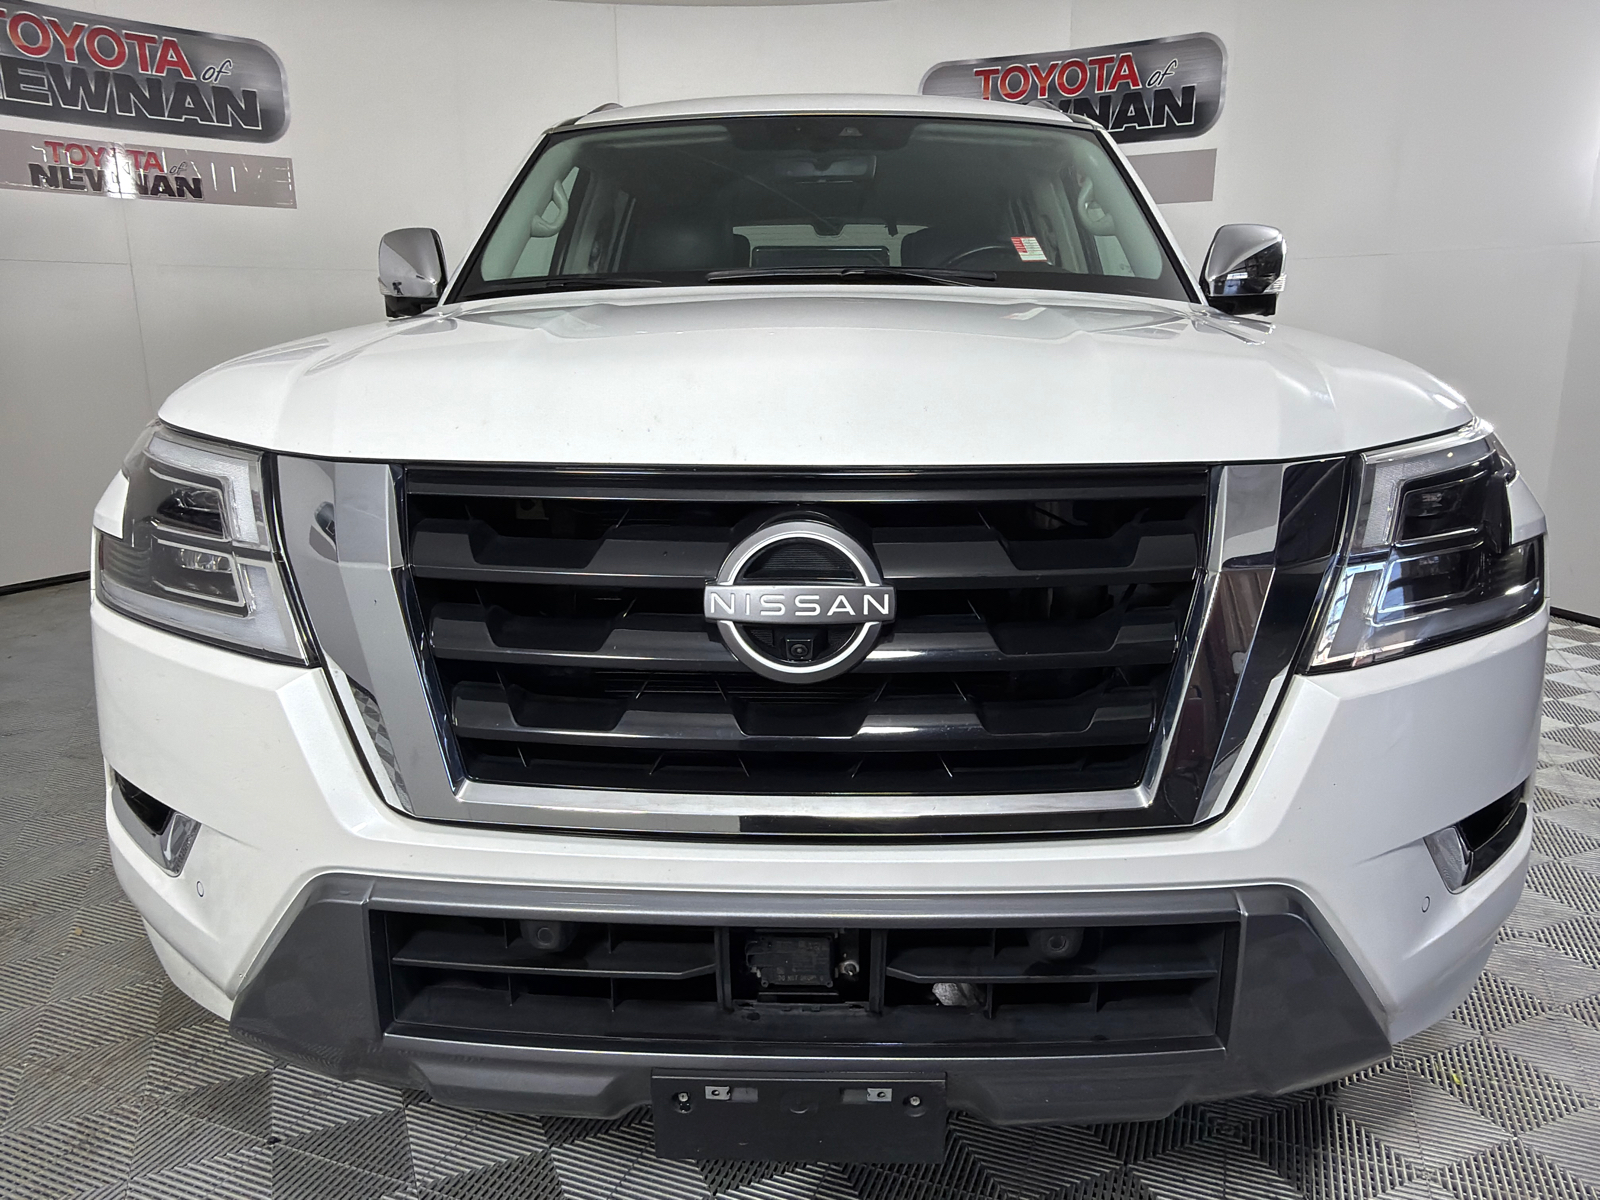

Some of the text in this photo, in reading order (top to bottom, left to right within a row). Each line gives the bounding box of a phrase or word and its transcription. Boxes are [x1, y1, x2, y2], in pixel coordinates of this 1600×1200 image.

[0, 8, 233, 83] OYOTA of
[0, 53, 262, 130] EWNAN
[974, 52, 1178, 100] TOYOTA of
[1057, 83, 1198, 132] NAN
[44, 140, 188, 175] TOYTA of
[710, 592, 889, 616] NISSAN
